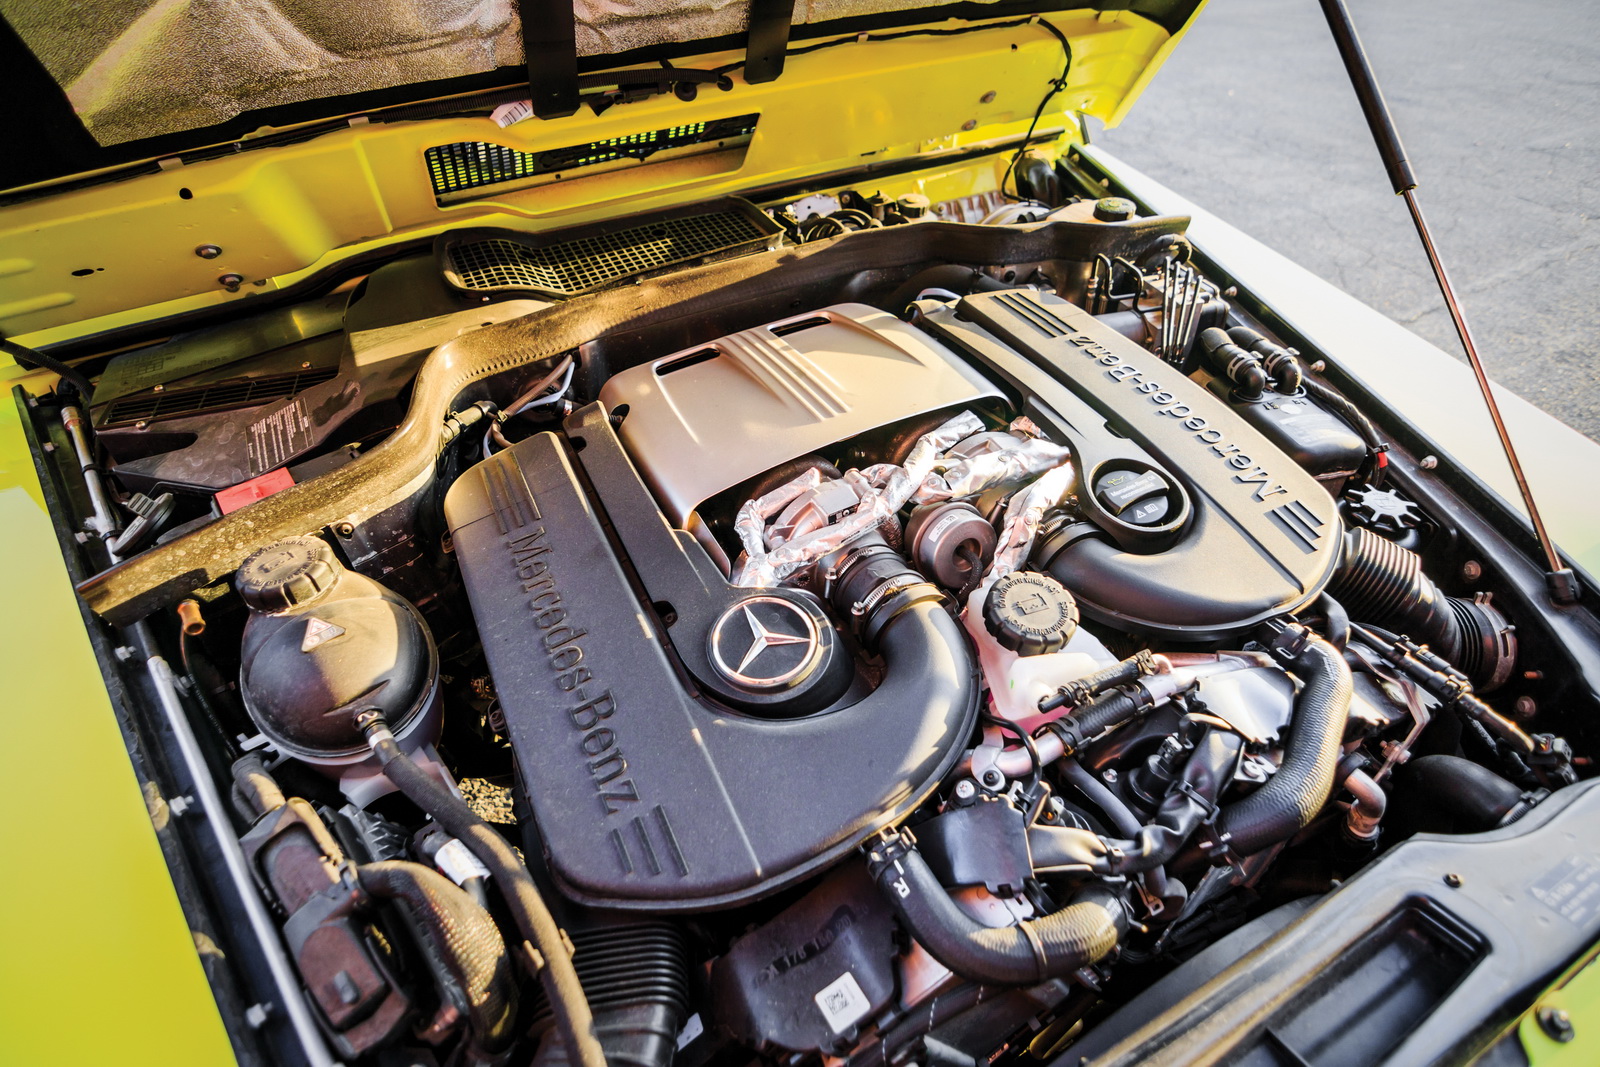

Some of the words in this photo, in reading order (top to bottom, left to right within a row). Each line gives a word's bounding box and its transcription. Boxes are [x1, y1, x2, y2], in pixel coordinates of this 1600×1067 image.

[1069, 334, 1289, 502] Mercedes-Benz
[508, 526, 640, 815] Mercedes-Benz
[893, 877, 910, 898] R
